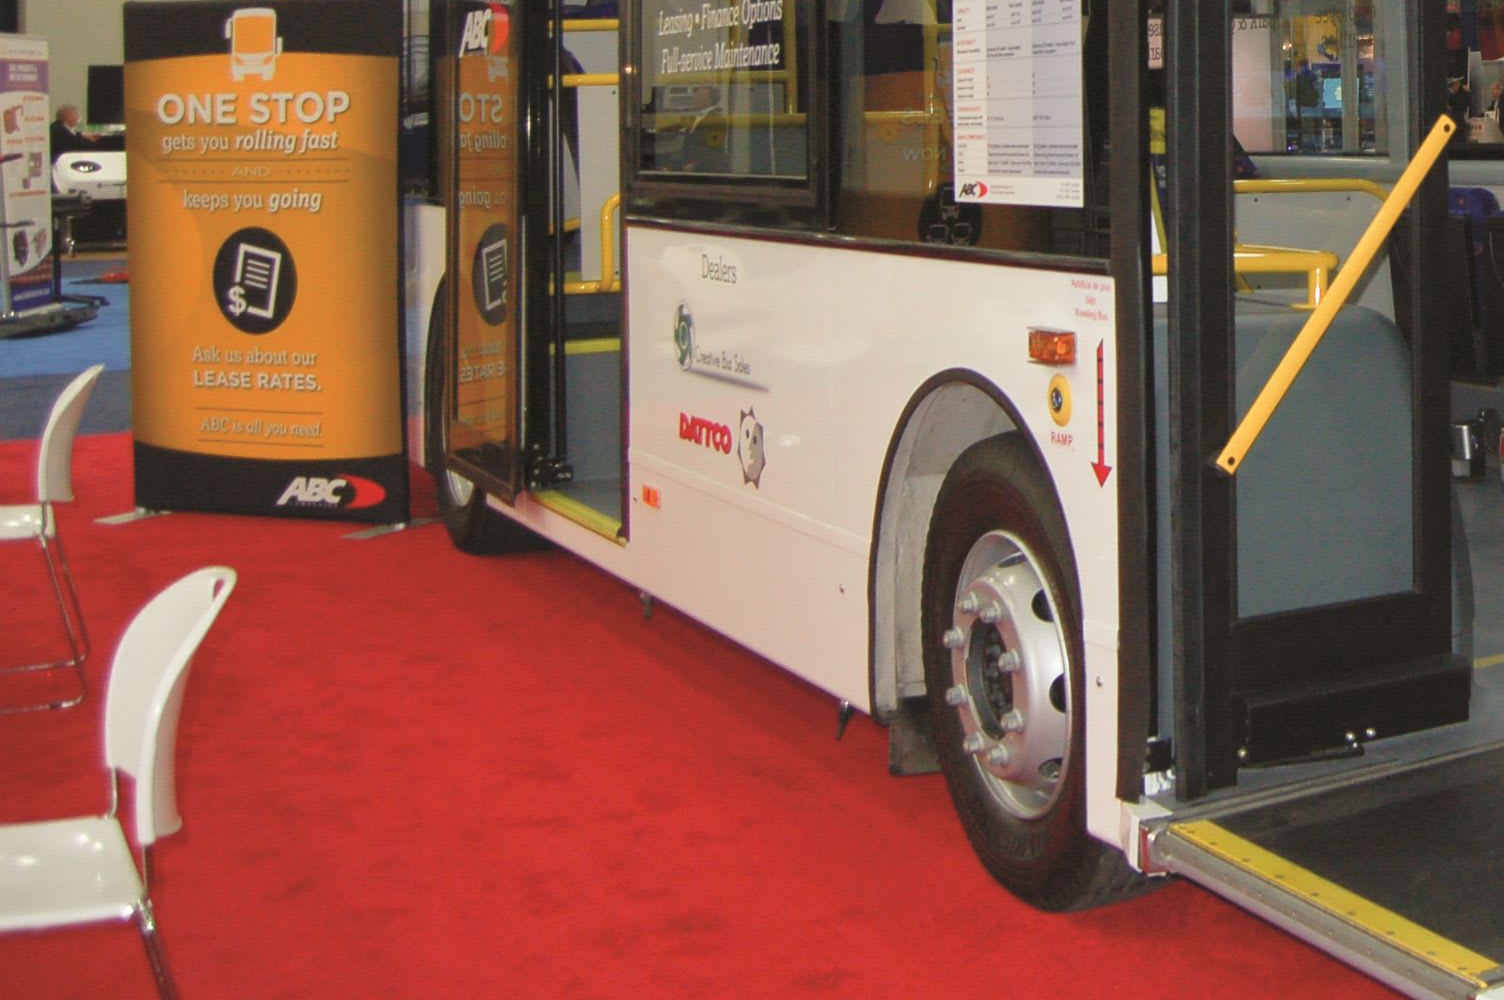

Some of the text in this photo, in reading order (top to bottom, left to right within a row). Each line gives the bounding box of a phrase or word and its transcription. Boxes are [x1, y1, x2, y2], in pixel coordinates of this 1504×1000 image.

[459, 8, 491, 58] ABC
[657, 10, 693, 38] Leasing
[700, 3, 739, 31] Finance
[661, 40, 780, 74] Full-service Maintenance
[157, 90, 350, 125] ONE STOP
[162, 129, 338, 154] gets you rolling fast
[232, 166, 271, 177] AND
[183, 188, 322, 213] keeps you going
[959, 181, 979, 198] ABC
[701, 253, 738, 284] Dealers
[192, 345, 318, 366] Ask us about our
[192, 369, 322, 392] LEASE RATES.
[201, 417, 231, 433] ABC
[233, 419, 243, 433] is
[247, 419, 262, 435] all
[265, 422, 288, 438] you
[680, 412, 732, 455] DATTCO
[1050, 431, 1073, 446] RAMP
[276, 477, 346, 506] ABC
